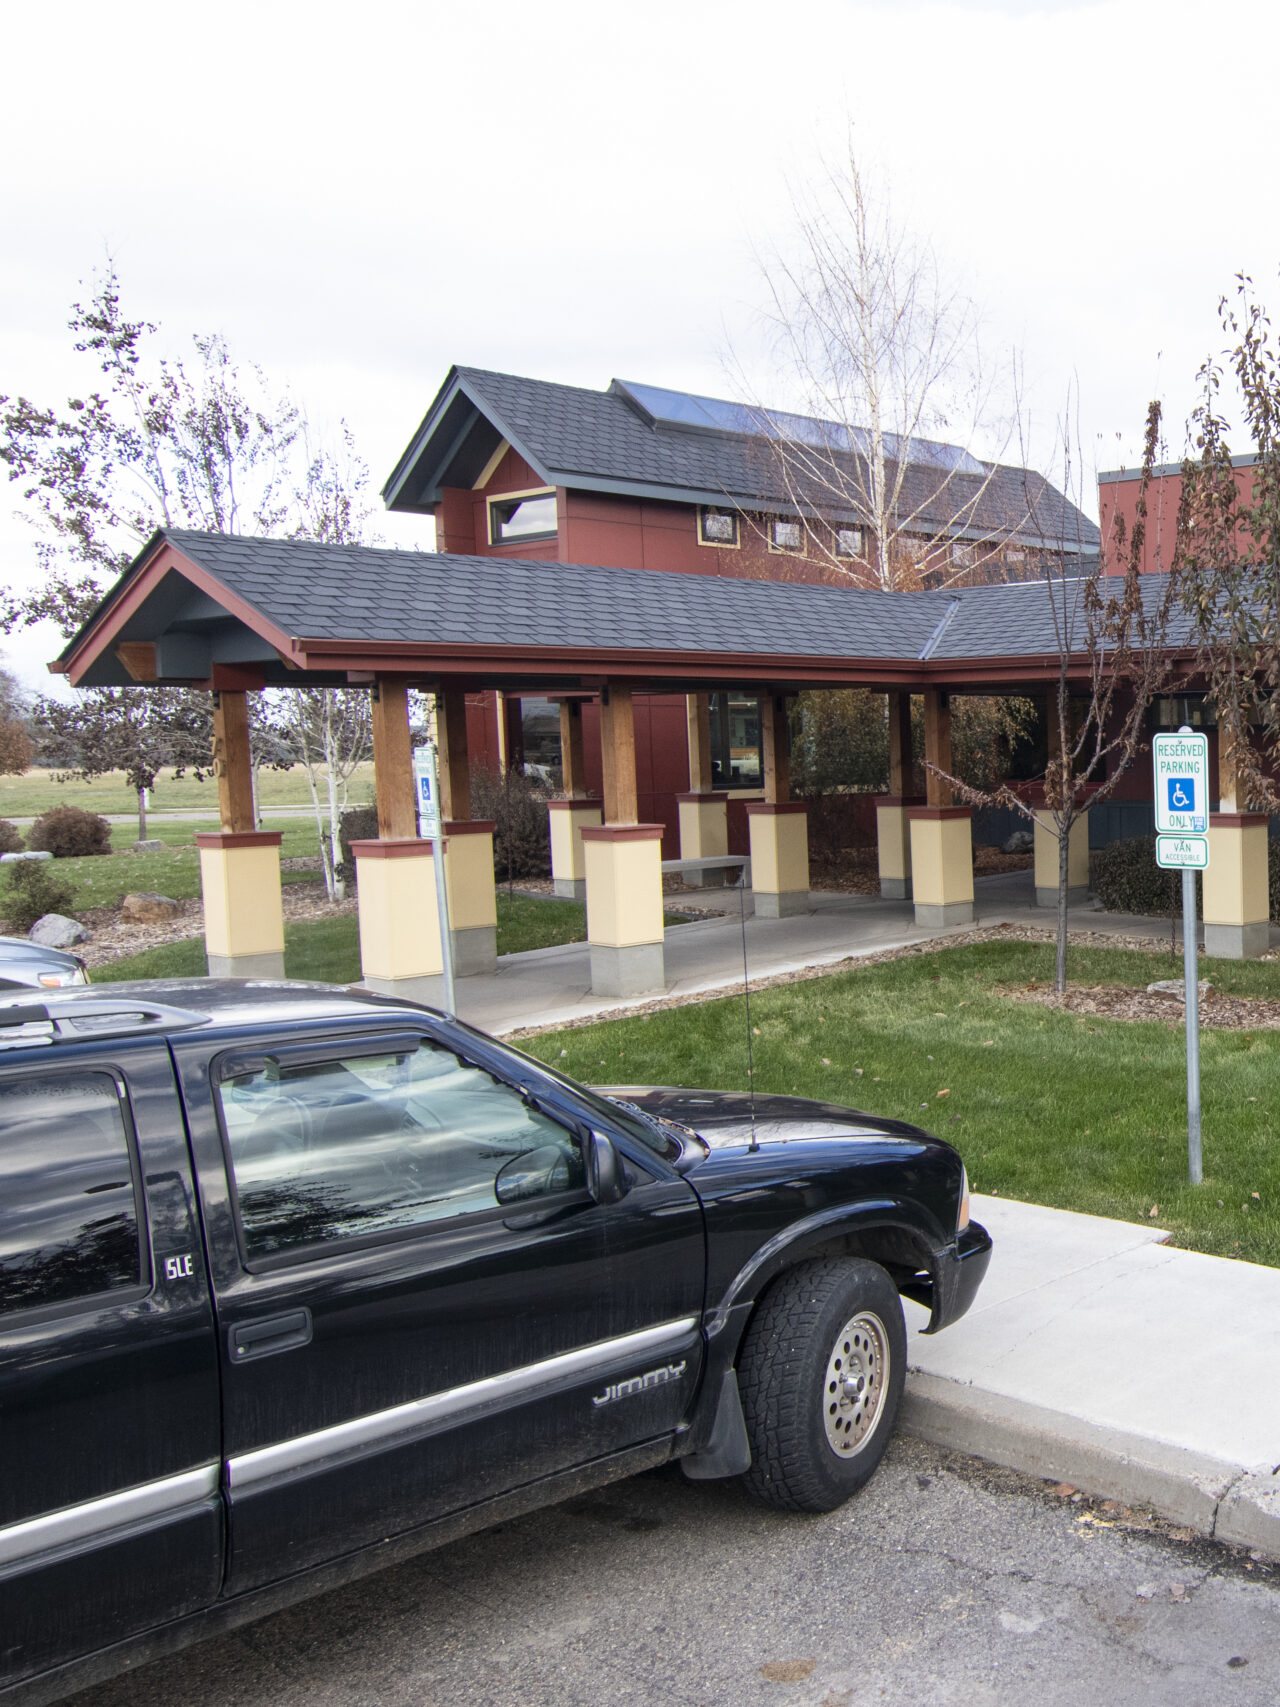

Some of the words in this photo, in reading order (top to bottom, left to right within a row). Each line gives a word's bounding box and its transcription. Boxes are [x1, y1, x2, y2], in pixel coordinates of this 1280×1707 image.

[1158, 744, 1204, 757] RESERVED
[1160, 761, 1200, 774] PARKING
[1169, 814, 1194, 828] ONLY
[1173, 842, 1191, 853] VAN
[1165, 853, 1200, 862] ACCESSIBLE
[166, 1254, 194, 1280] SLE
